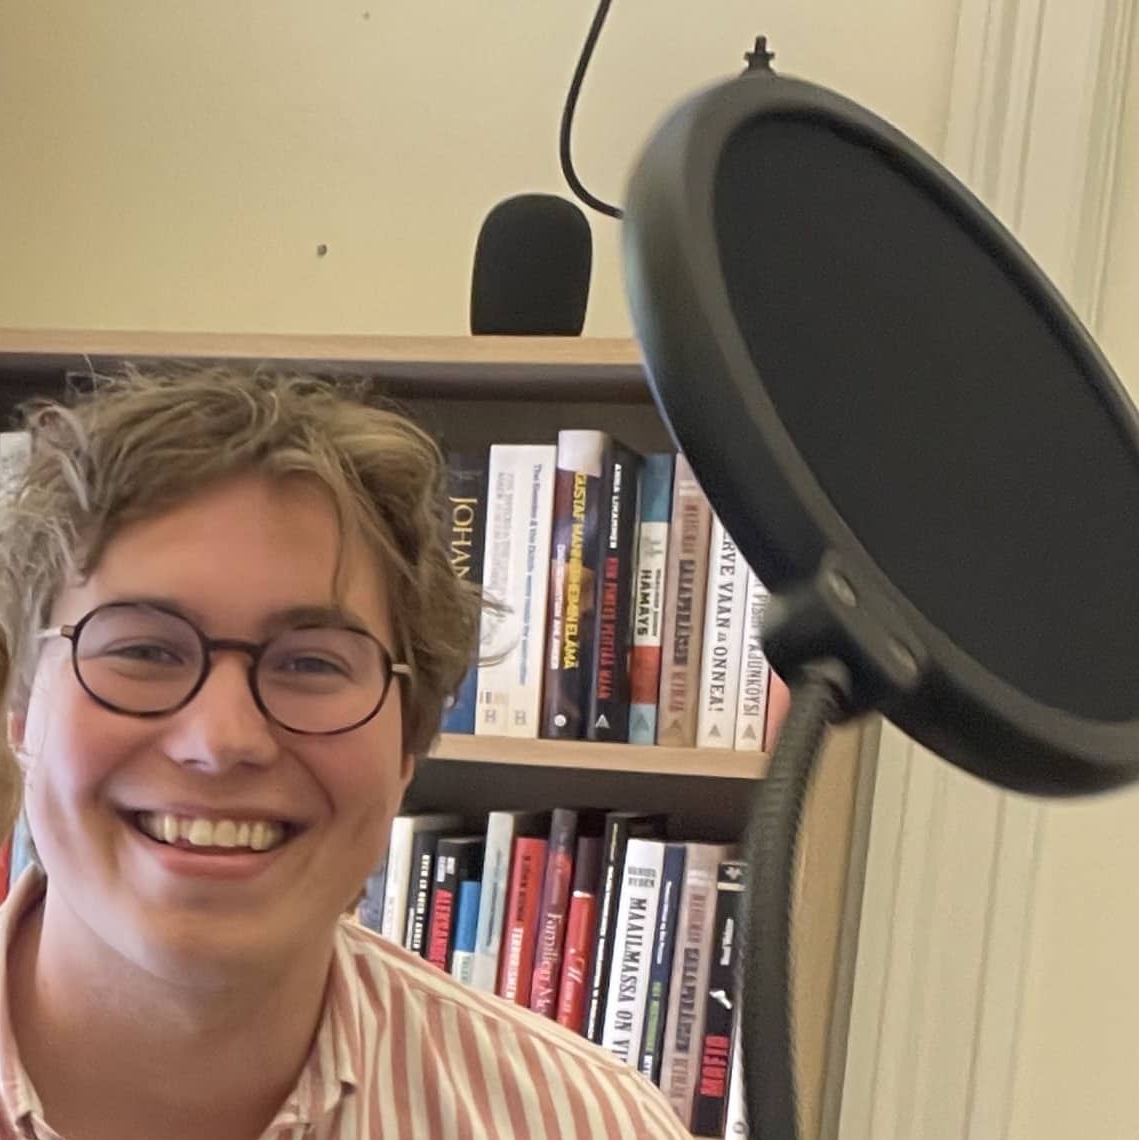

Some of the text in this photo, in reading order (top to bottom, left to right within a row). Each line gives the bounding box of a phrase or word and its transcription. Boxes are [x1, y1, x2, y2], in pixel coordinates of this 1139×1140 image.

[716, 582, 734, 628] VAAN
[708, 647, 729, 712] ONNEA!
[618, 898, 647, 1002] MAAILMASSA
[615, 1010, 633, 1032] ON
